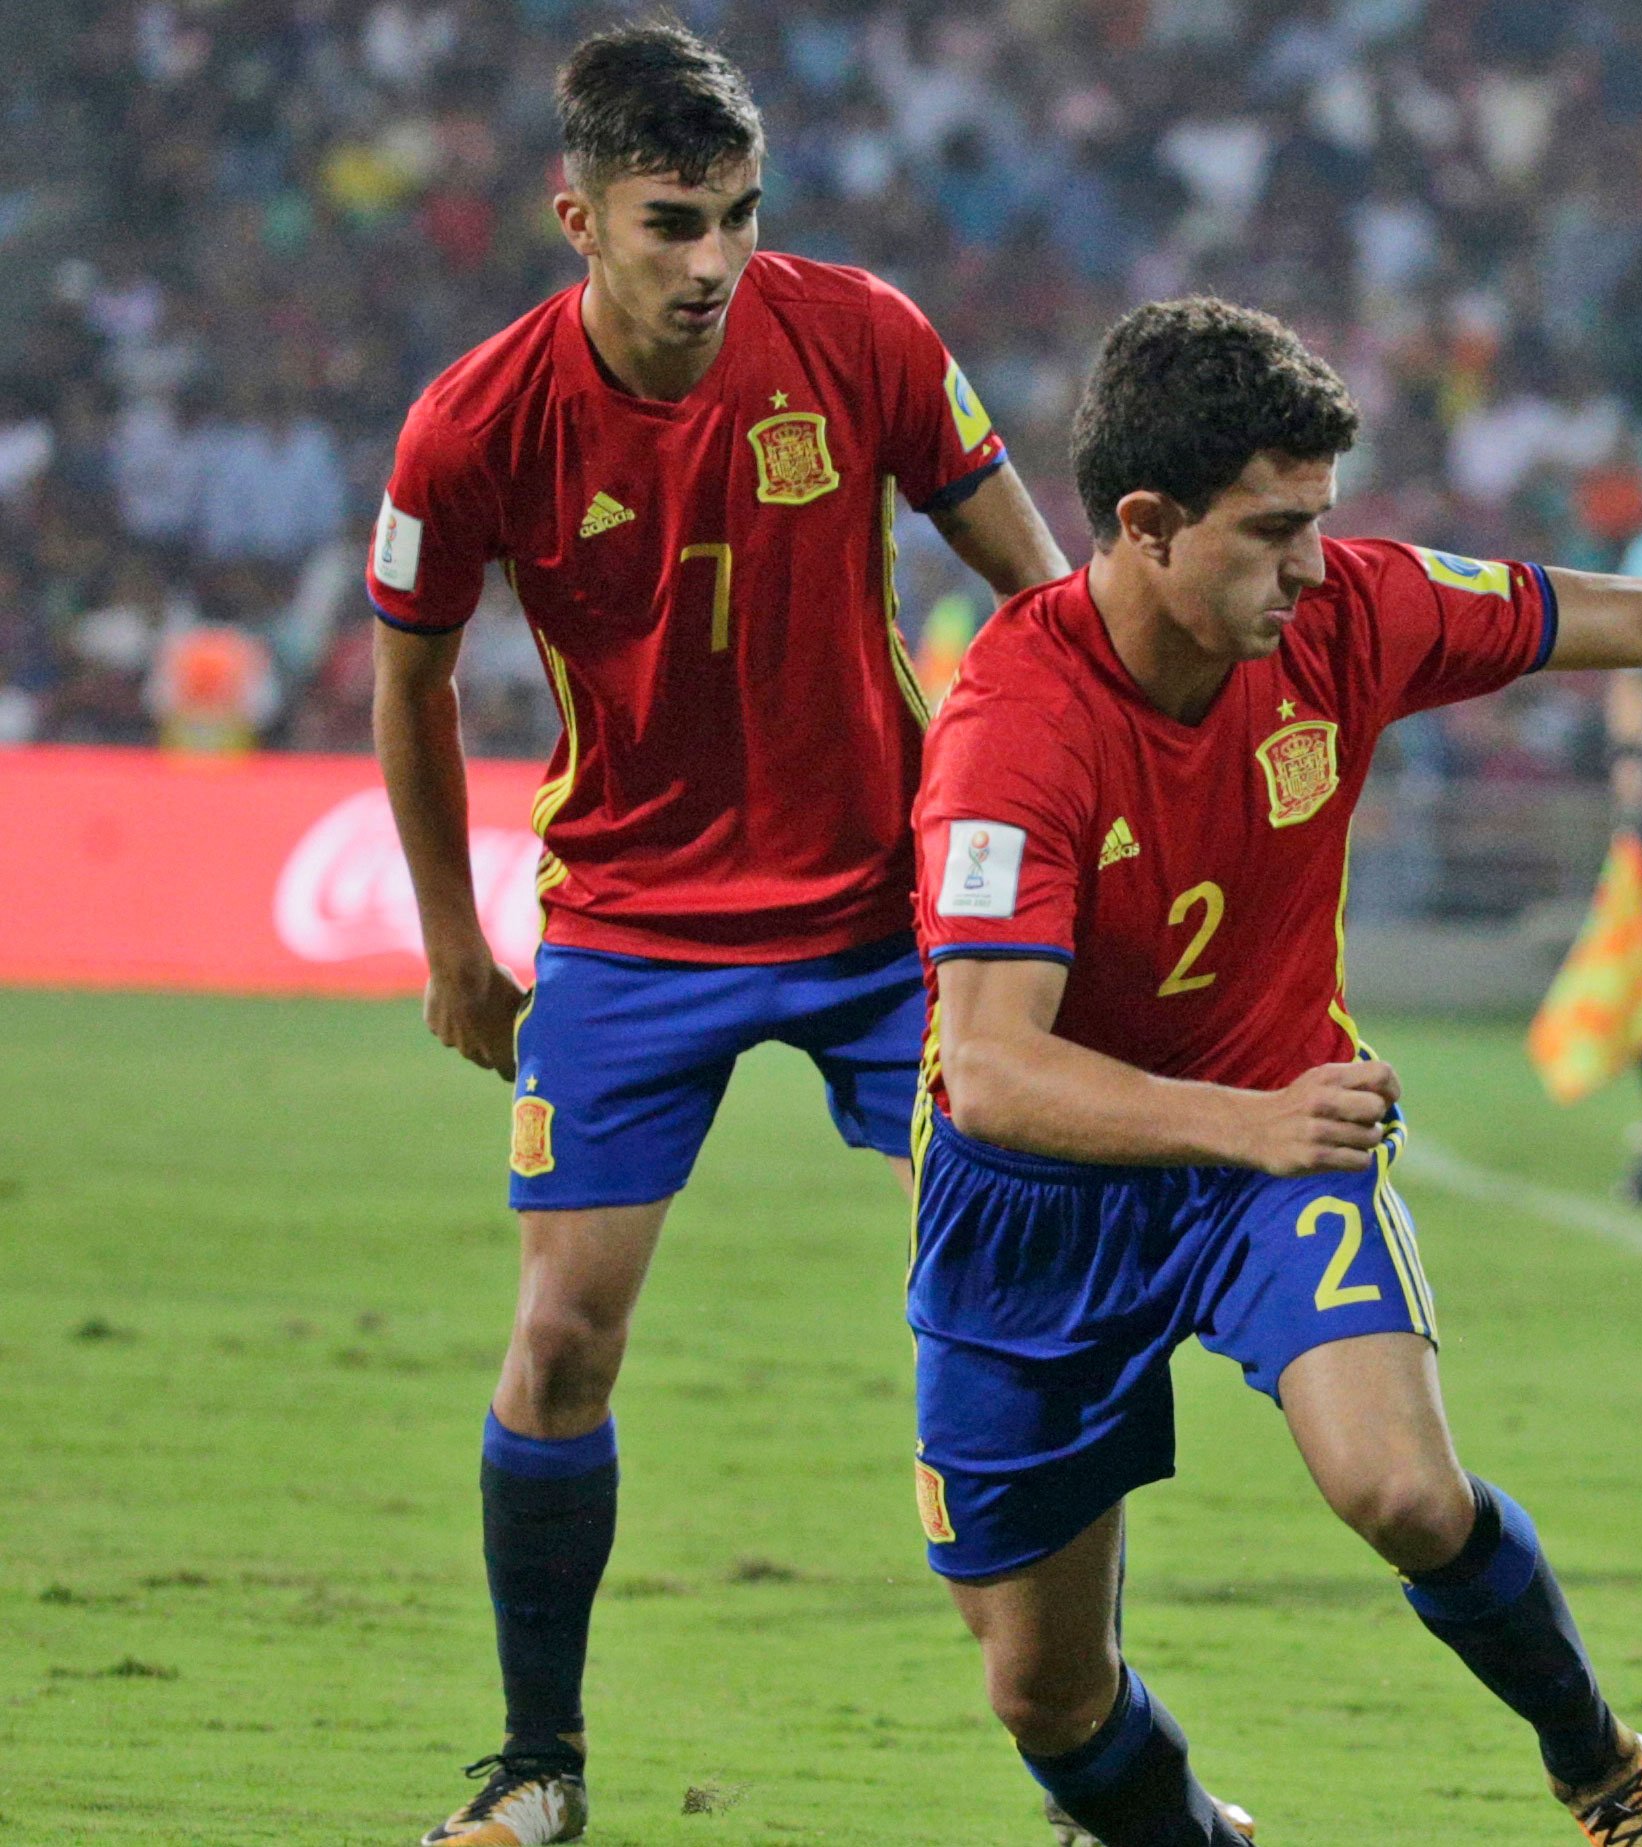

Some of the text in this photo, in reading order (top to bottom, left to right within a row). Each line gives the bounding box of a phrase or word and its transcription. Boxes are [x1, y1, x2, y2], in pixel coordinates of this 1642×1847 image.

[579, 508, 636, 539] adidas
[680, 543, 732, 653] 7
[1098, 842, 1140, 870] didas
[1157, 881, 1225, 997] 2
[1296, 1195, 1382, 1311] 2
